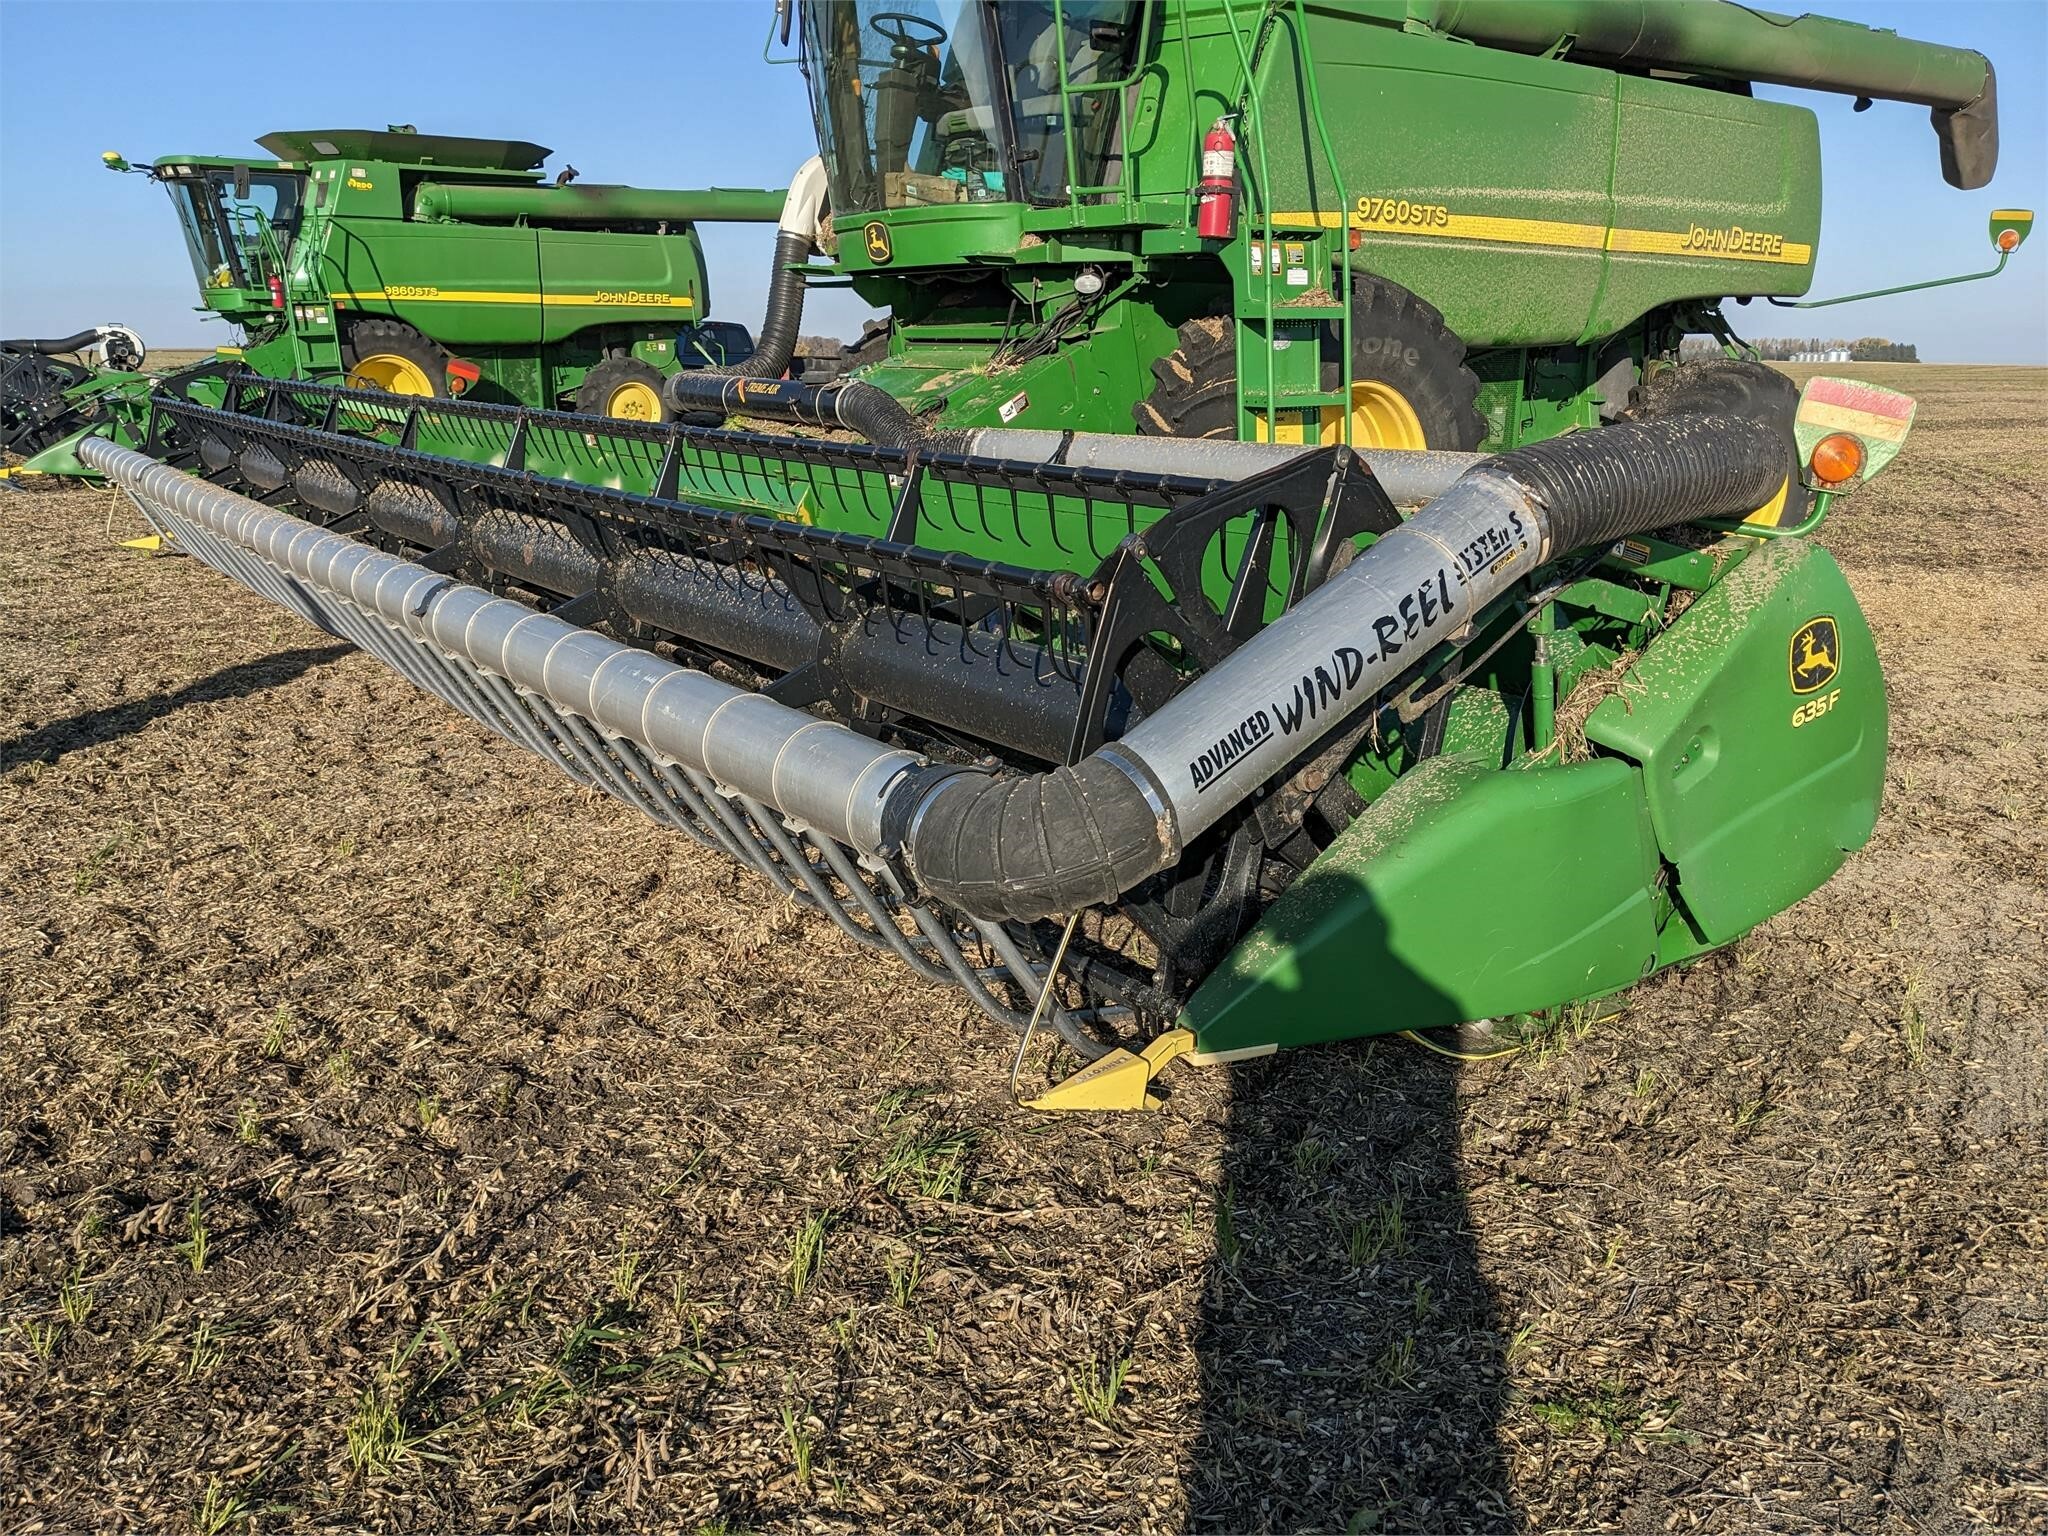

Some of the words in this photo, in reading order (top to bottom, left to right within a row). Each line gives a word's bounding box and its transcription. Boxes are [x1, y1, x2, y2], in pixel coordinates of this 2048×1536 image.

[1357, 196, 1448, 226] 9760STS
[384, 286, 438, 297] 9860STS
[1189, 710, 1272, 790] ADVANCED
[1272, 569, 1454, 736] WIND-REEL
[1792, 688, 1841, 728] 635F
